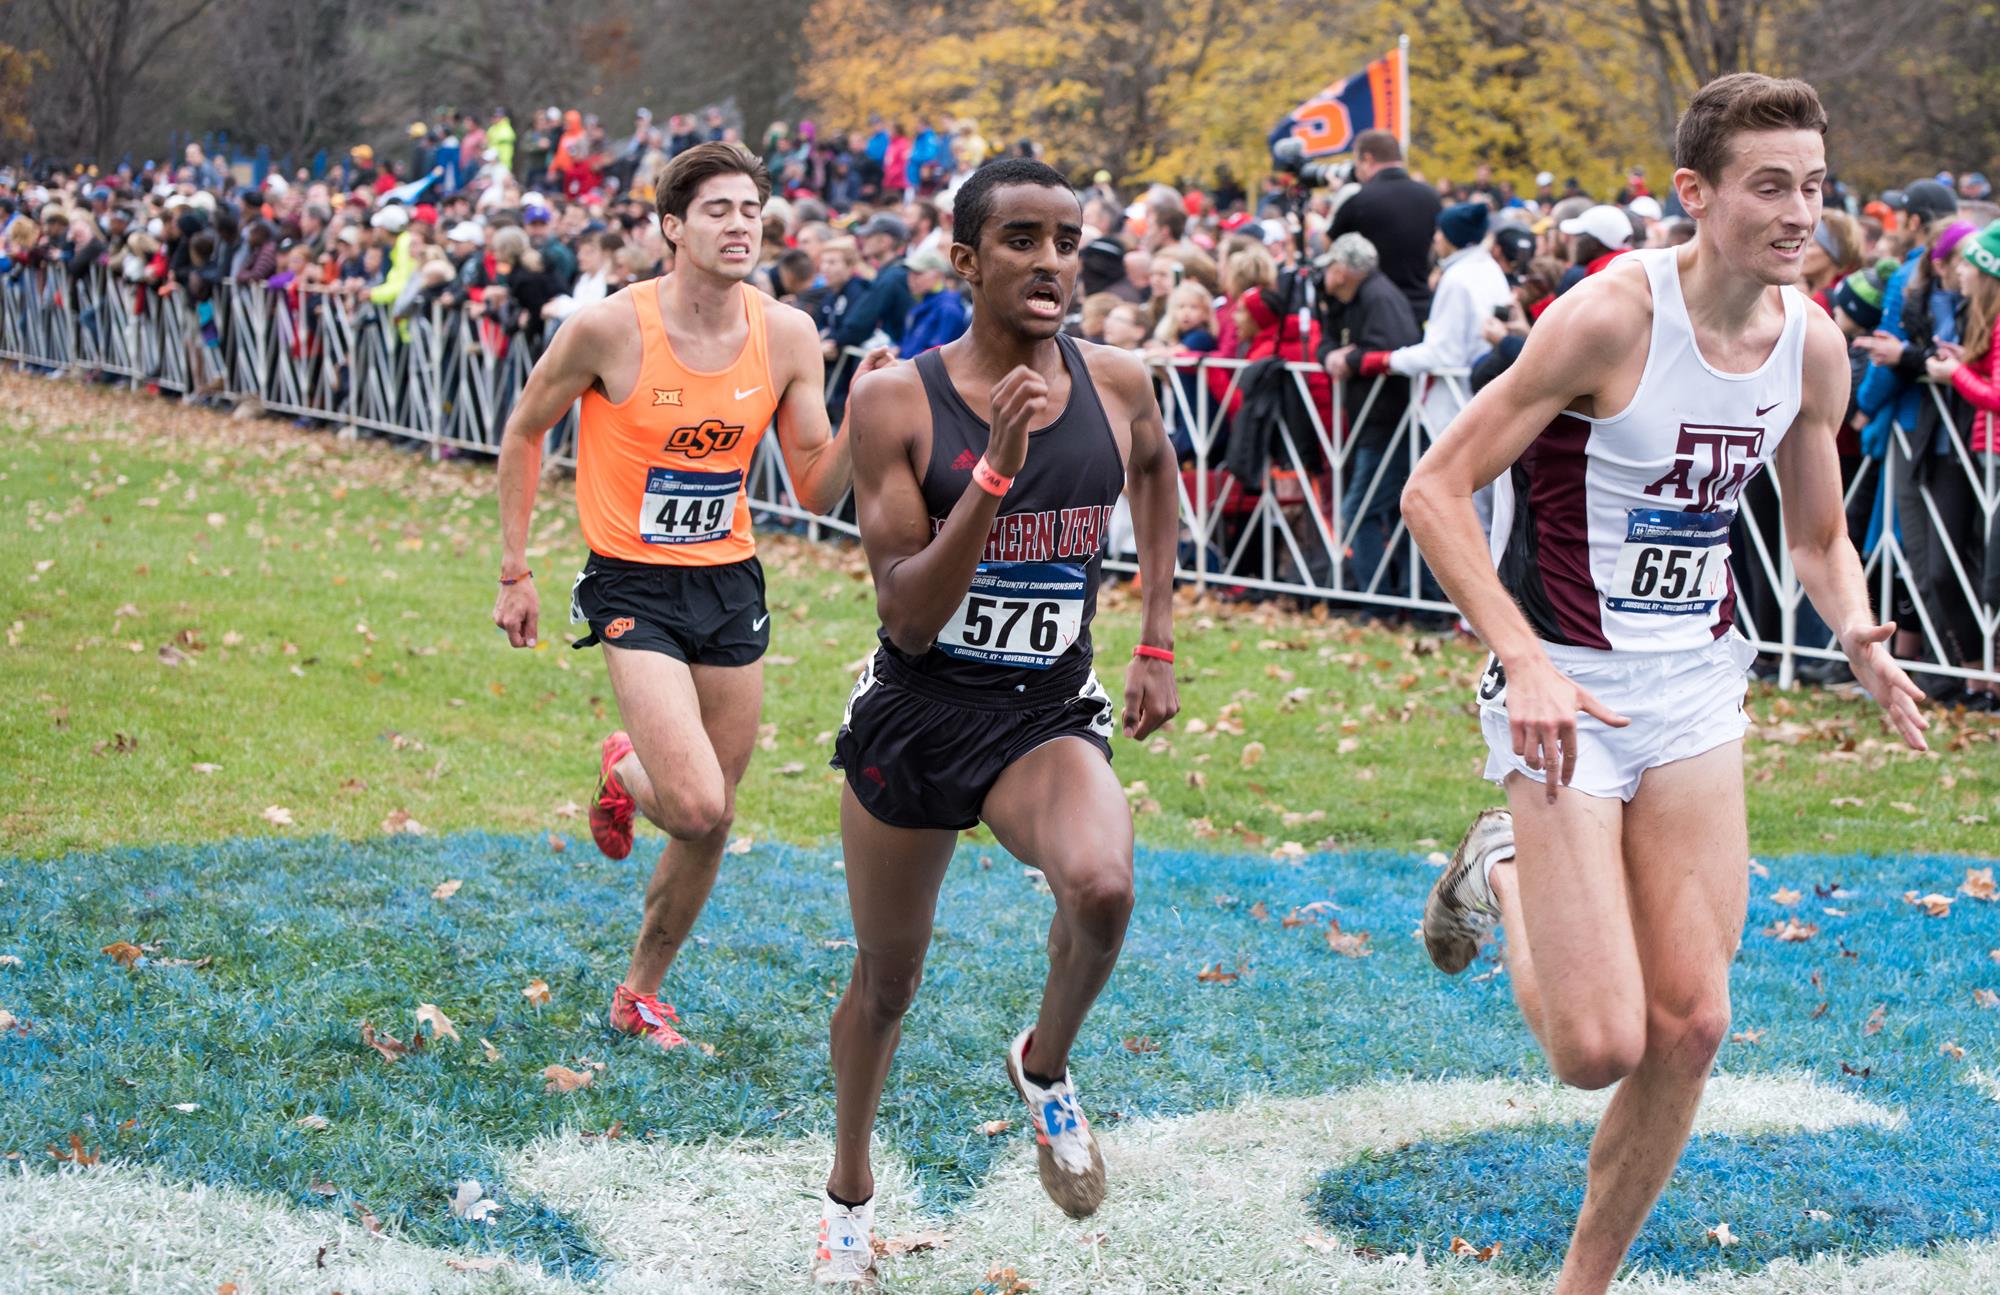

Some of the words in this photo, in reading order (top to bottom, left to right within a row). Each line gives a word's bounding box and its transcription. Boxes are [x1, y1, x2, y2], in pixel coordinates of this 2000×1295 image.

[664, 419, 745, 459] OSU
[656, 498, 725, 534] 449
[971, 577, 995, 586] CROSS
[997, 580, 1029, 589] COUNTRY
[1029, 581, 1084, 590] CHAMPIONSHIPS
[1631, 547, 1710, 599] 651
[962, 596, 1062, 652] 576
[1002, 654, 1036, 664] NOVEMBER
